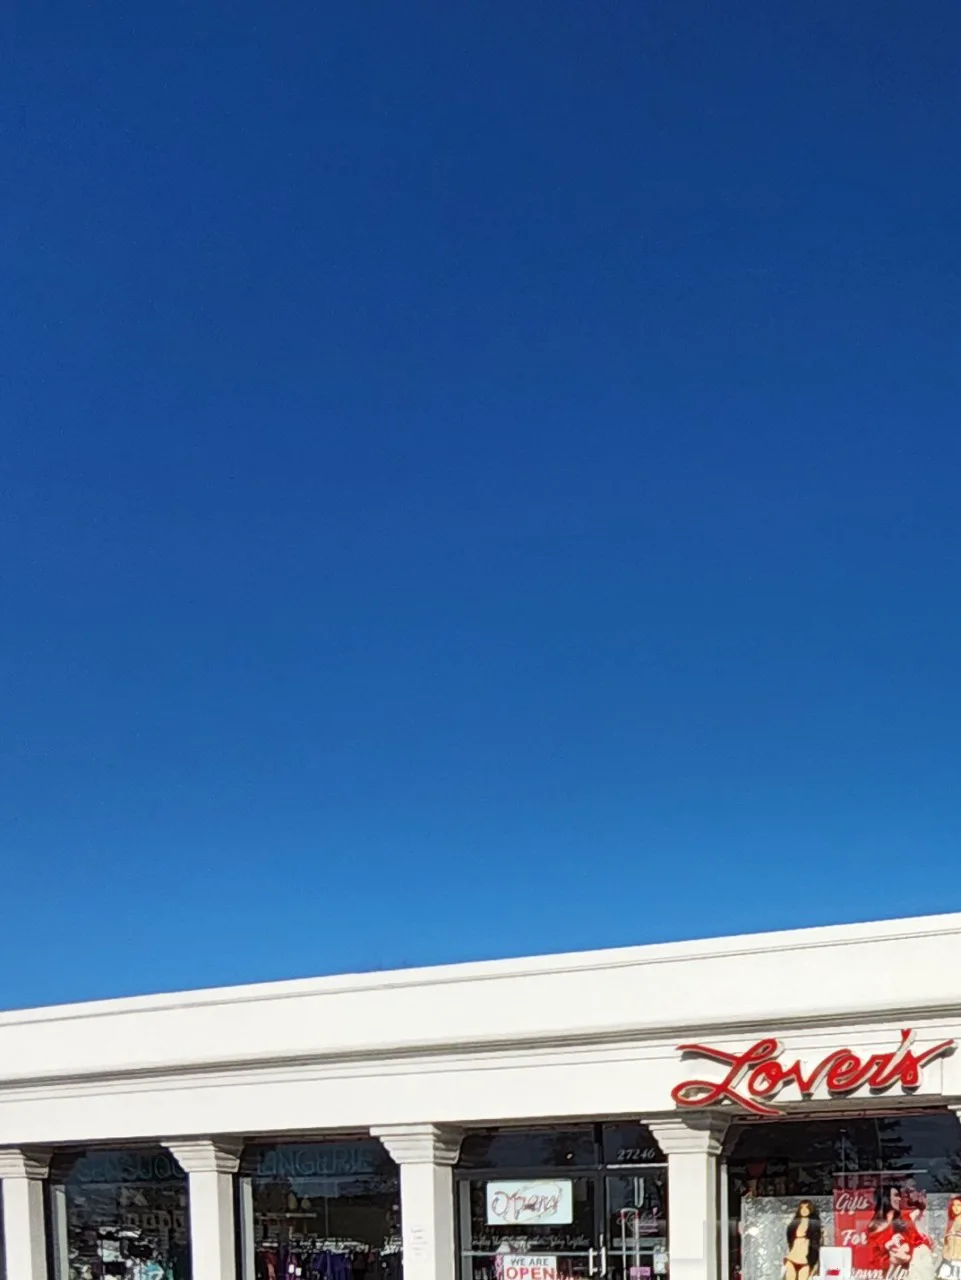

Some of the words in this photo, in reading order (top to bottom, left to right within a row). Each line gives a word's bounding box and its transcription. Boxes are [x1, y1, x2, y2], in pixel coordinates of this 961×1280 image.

[671, 1029, 956, 1115] Lover's
[256, 1146, 373, 1175] LINGERIE
[617, 1148, 655, 1160] 27246
[836, 1193, 869, 1214] Gifts
[841, 1229, 868, 1245] For
[505, 1266, 555, 1280] OPEN
